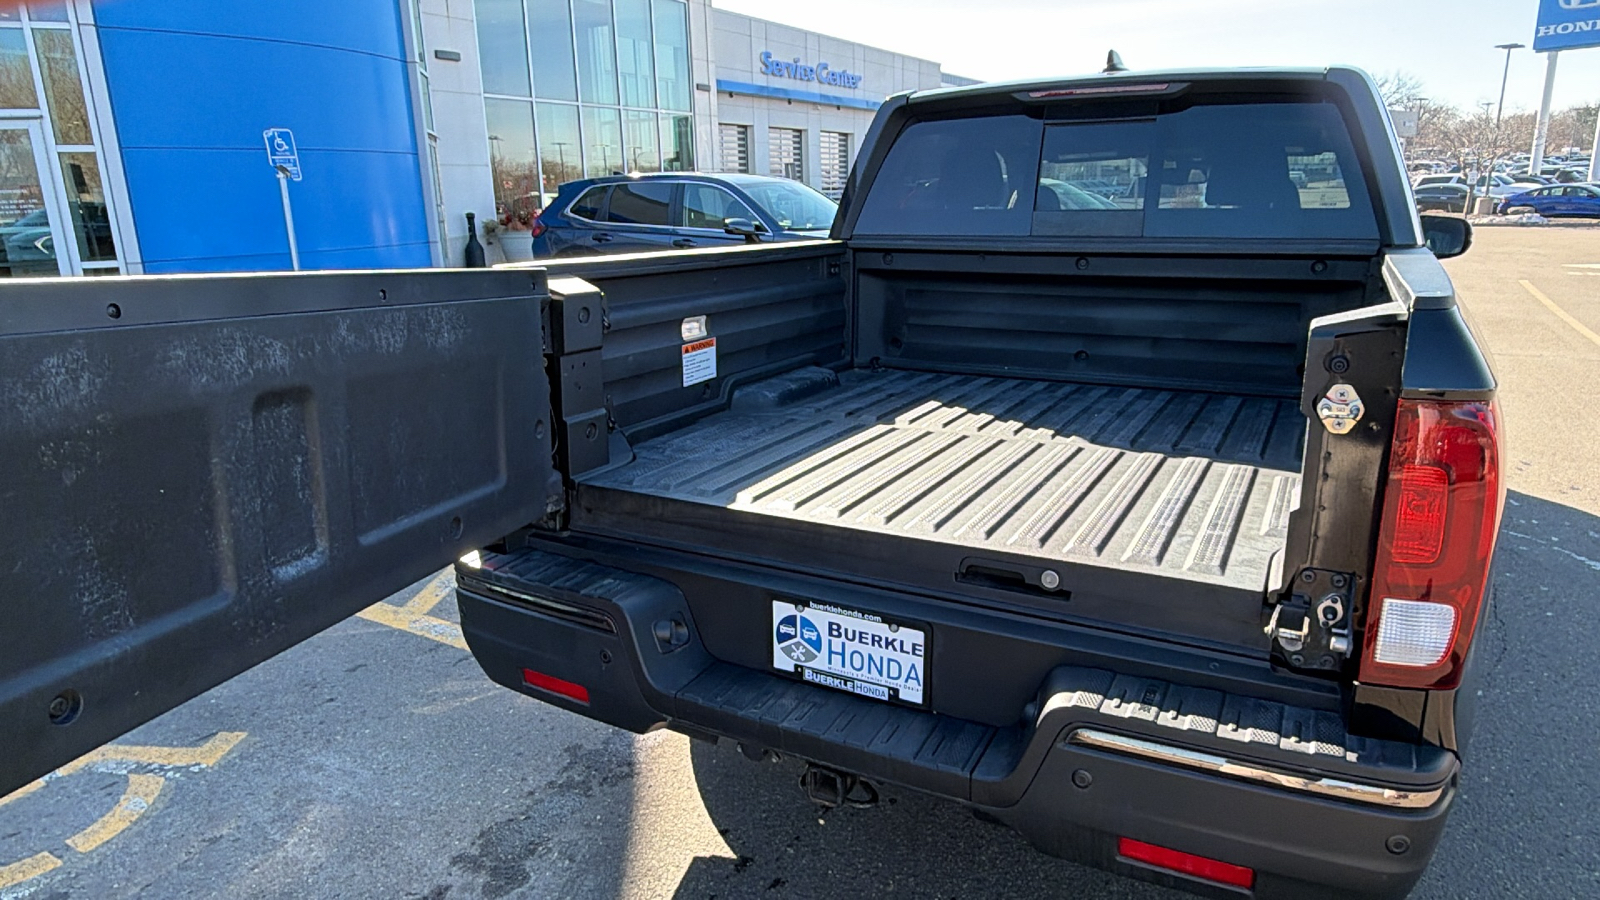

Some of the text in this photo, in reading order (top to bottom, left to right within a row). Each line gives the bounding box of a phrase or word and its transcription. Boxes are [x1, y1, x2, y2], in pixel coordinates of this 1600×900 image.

[760, 51, 862, 89] Service Center
[691, 339, 714, 351] WARNING
[809, 601, 882, 623] buerklehonda.com
[828, 621, 923, 658] BUERKLE
[828, 639, 921, 687] HONDA
[805, 669, 886, 698] BUERKLE HONDA
